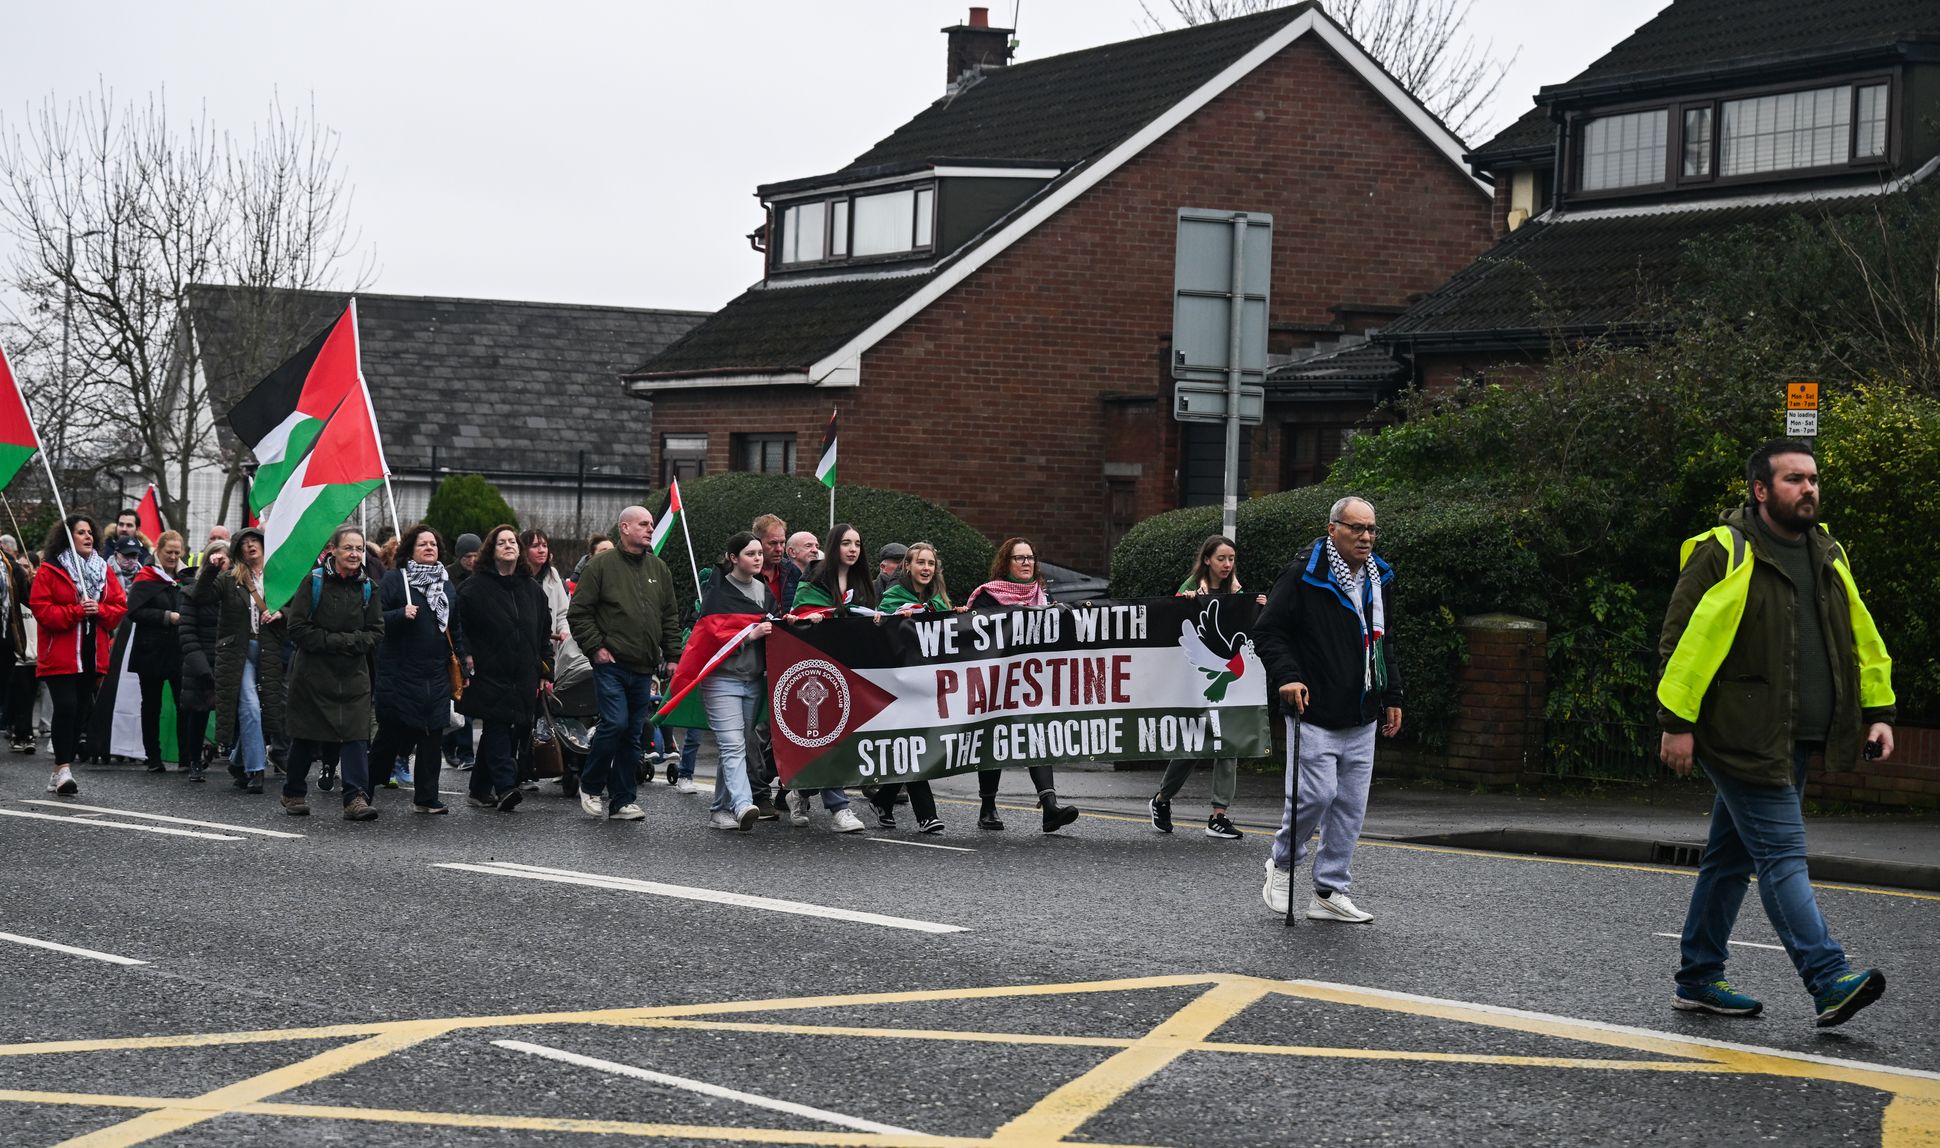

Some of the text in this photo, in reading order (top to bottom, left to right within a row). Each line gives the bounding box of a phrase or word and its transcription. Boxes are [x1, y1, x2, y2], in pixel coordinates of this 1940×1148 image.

[915, 604, 1147, 658] WE STAND WITH
[781, 669, 822, 711] ANDERSONSTOWN
[822, 671, 840, 690] SOCIAL
[935, 655, 1132, 719] PALESTINE
[858, 709, 1223, 776] STOP THE GENOCIDE NOW!
